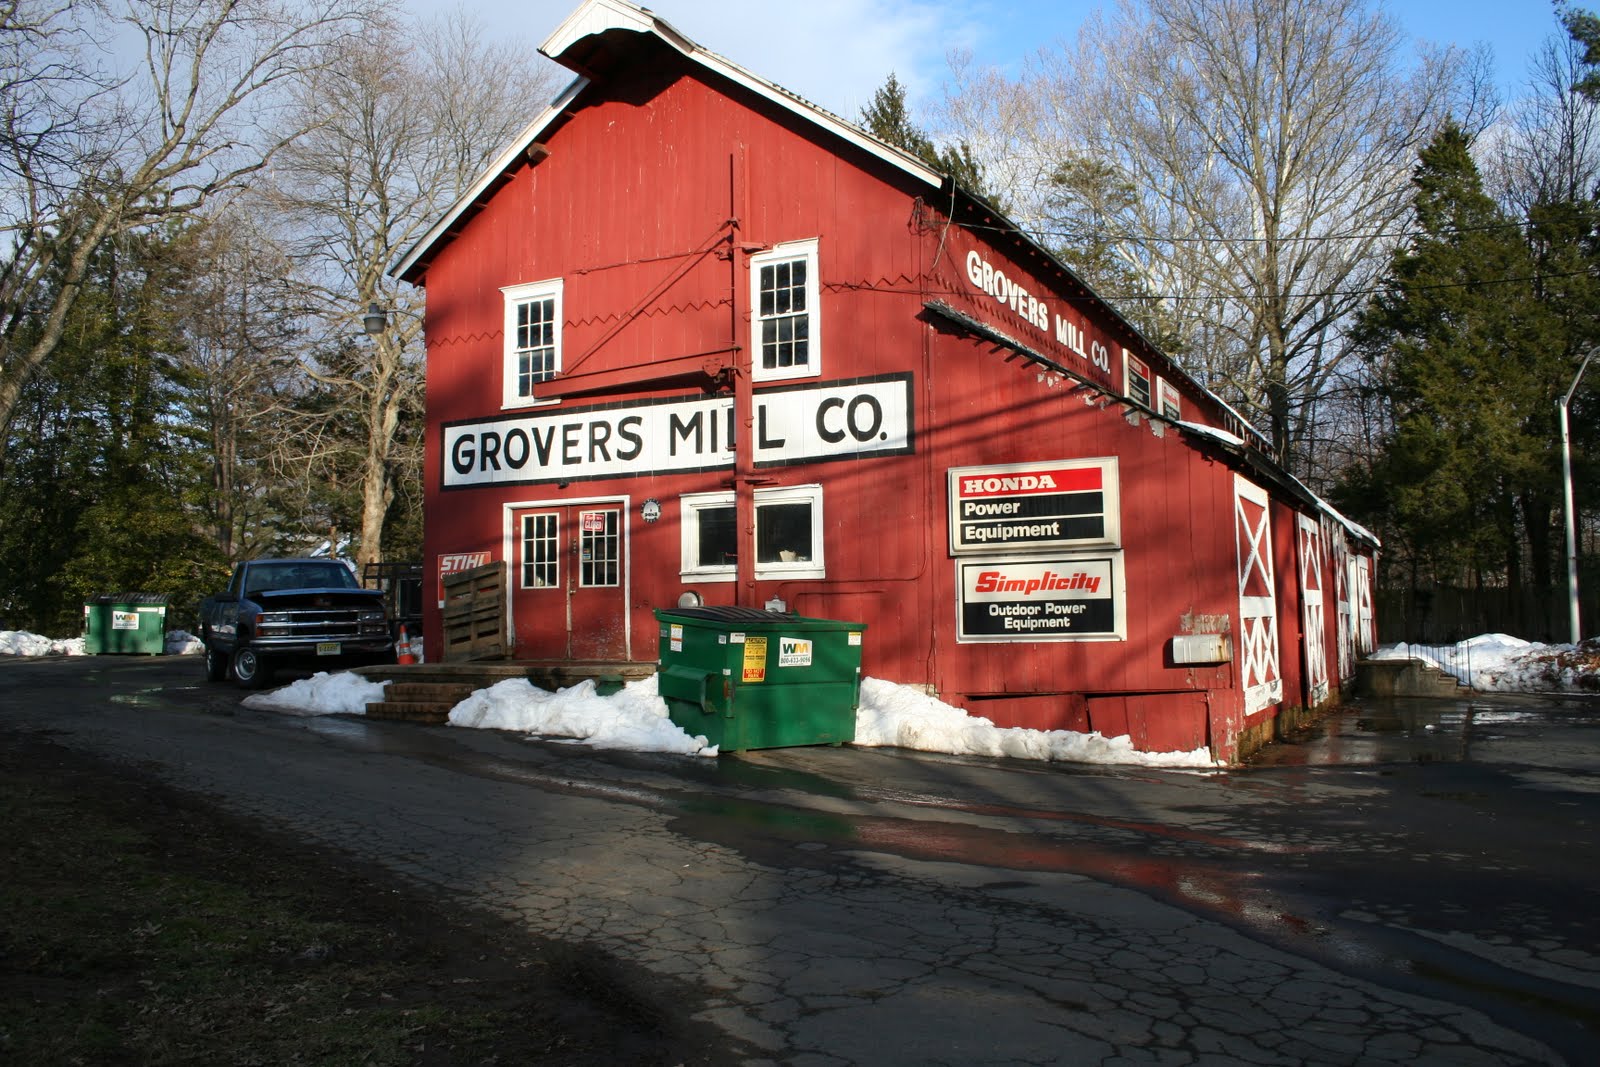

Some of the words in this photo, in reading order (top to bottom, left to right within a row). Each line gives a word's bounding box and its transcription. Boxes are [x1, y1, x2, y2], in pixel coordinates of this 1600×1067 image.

[967, 250, 1048, 332] GROVERS
[1056, 314, 1087, 359] MILL
[1092, 340, 1111, 374] CO.
[452, 416, 643, 475] GROVERS
[816, 394, 888, 443] CO.
[964, 475, 1057, 493] HONDA
[964, 502, 1020, 516] Power
[965, 522, 1060, 541] Equipment
[440, 554, 485, 571] STIHL
[975, 571, 1101, 595] Simplicity
[989, 604, 1041, 616] Outdoor
[1045, 602, 1086, 615] Power
[1004, 617, 1070, 630] Equipment
[783, 643, 809, 654] WM
